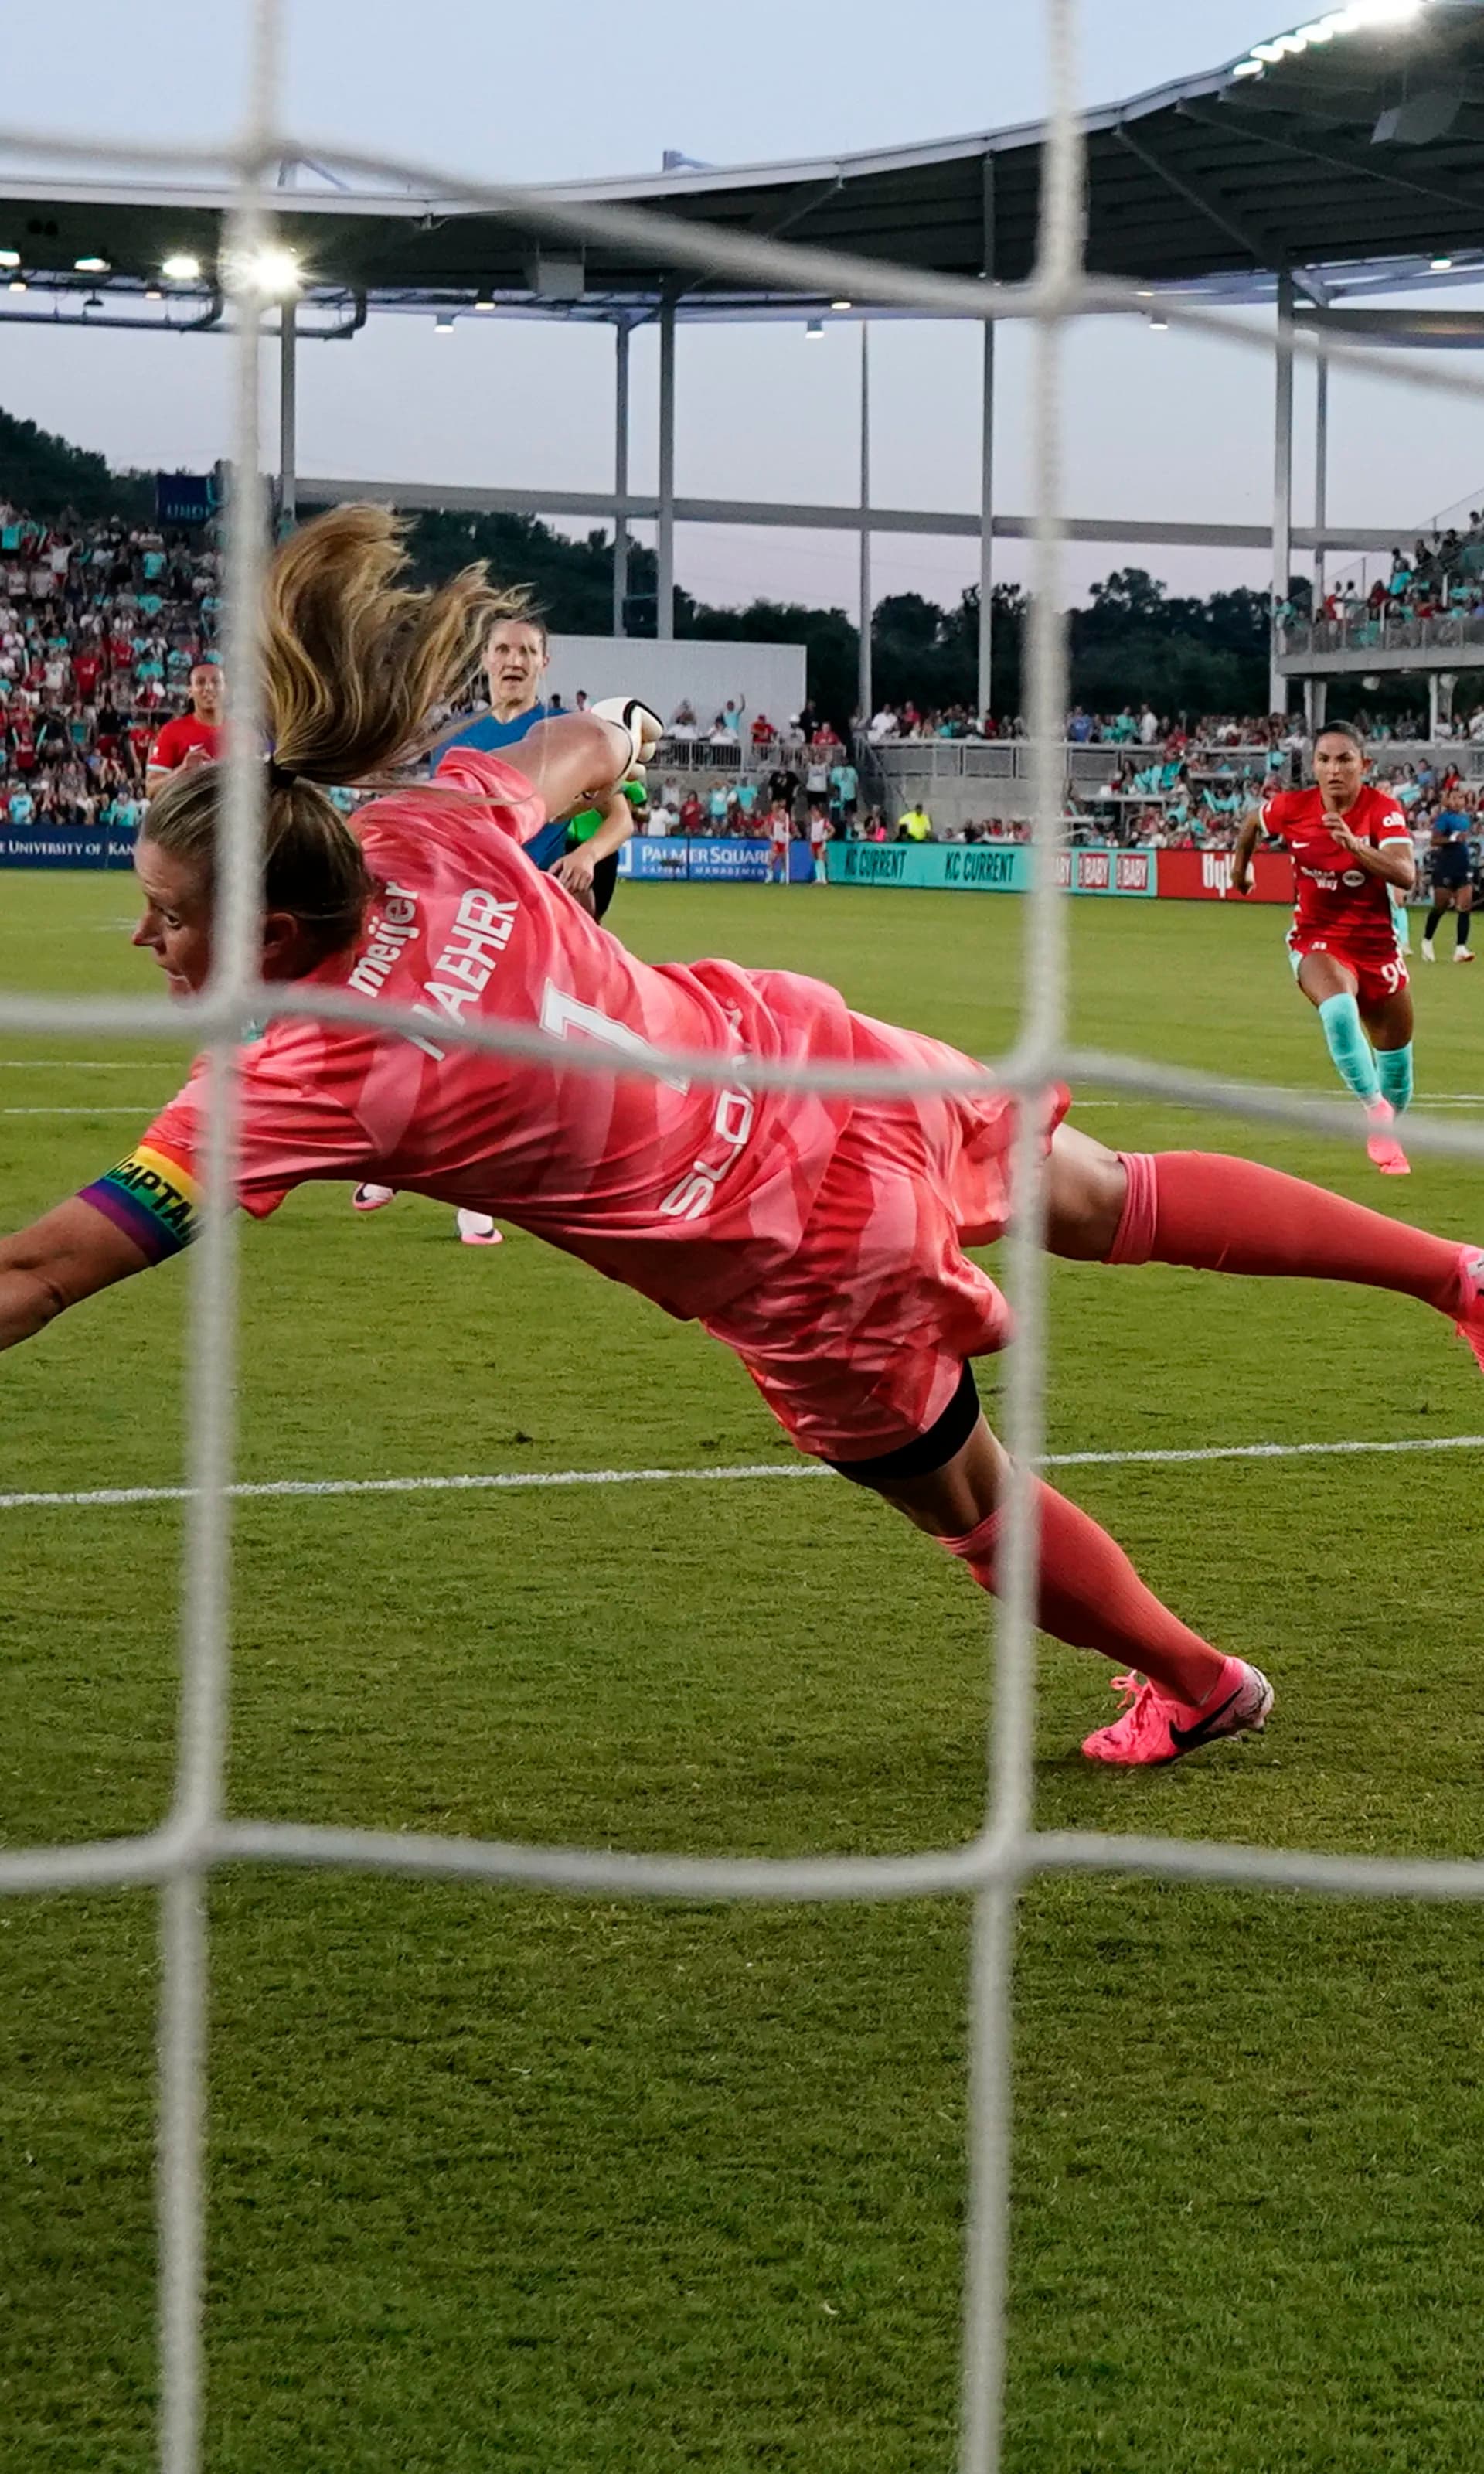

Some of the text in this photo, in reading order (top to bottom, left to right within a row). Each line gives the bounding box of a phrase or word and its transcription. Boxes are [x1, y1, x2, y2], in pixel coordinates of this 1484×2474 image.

[9, 840, 83, 855] UNIVERSITY
[85, 842, 102, 855] OF
[642, 844, 708, 864] PALMER
[845, 850, 907, 879] KC CURRENT
[945, 852, 1015, 882] KC CURRENT
[348, 881, 420, 997] meijer
[539, 977, 691, 1096] 1
